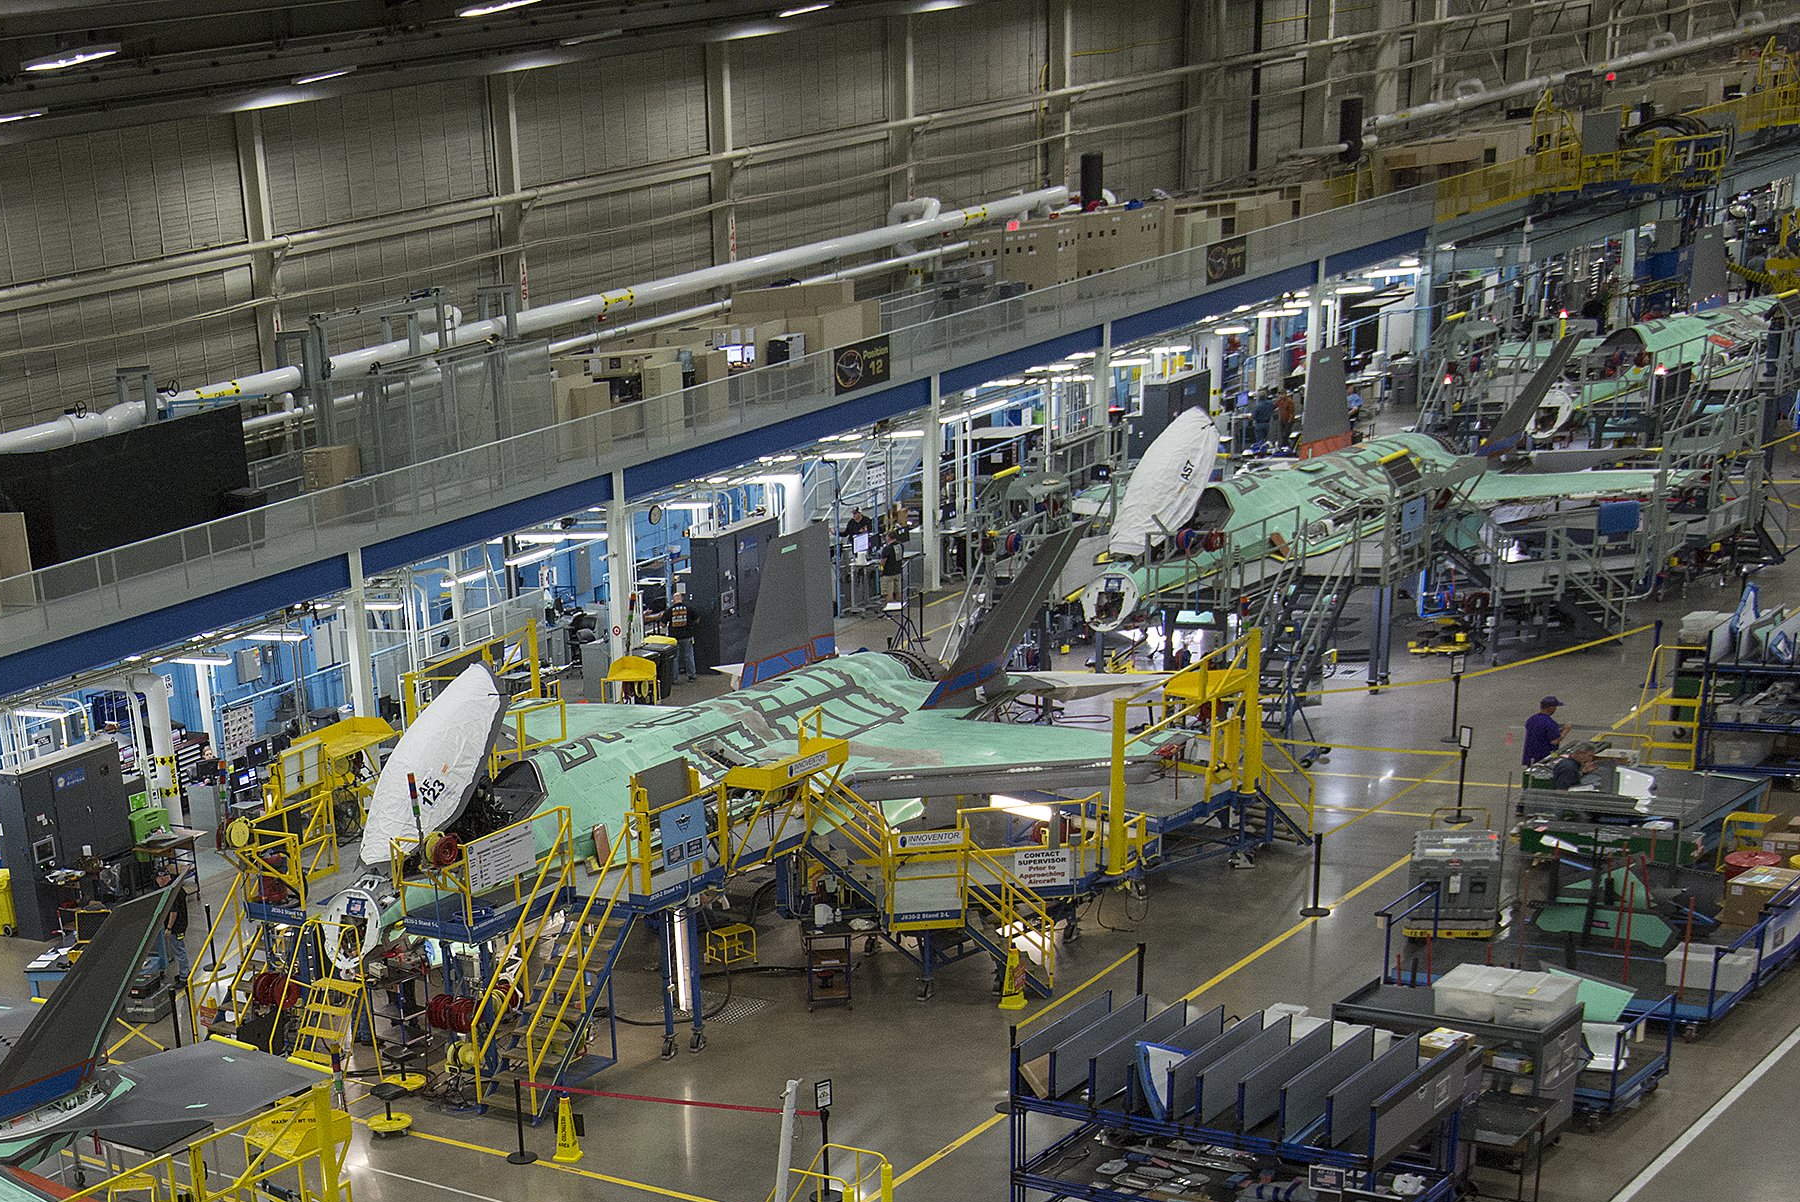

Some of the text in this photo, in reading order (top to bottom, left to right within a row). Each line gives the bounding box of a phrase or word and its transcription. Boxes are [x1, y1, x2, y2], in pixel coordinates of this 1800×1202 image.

[520, 263, 529, 300] 145
[862, 346, 889, 361] Position
[869, 359, 884, 376] 12
[418, 779, 431, 796] AF
[422, 779, 445, 806] 123
[1017, 857, 1067, 866] SUPERVISOR
[1023, 851, 1060, 859] CONTACT
[1018, 871, 1066, 879] Approaching
